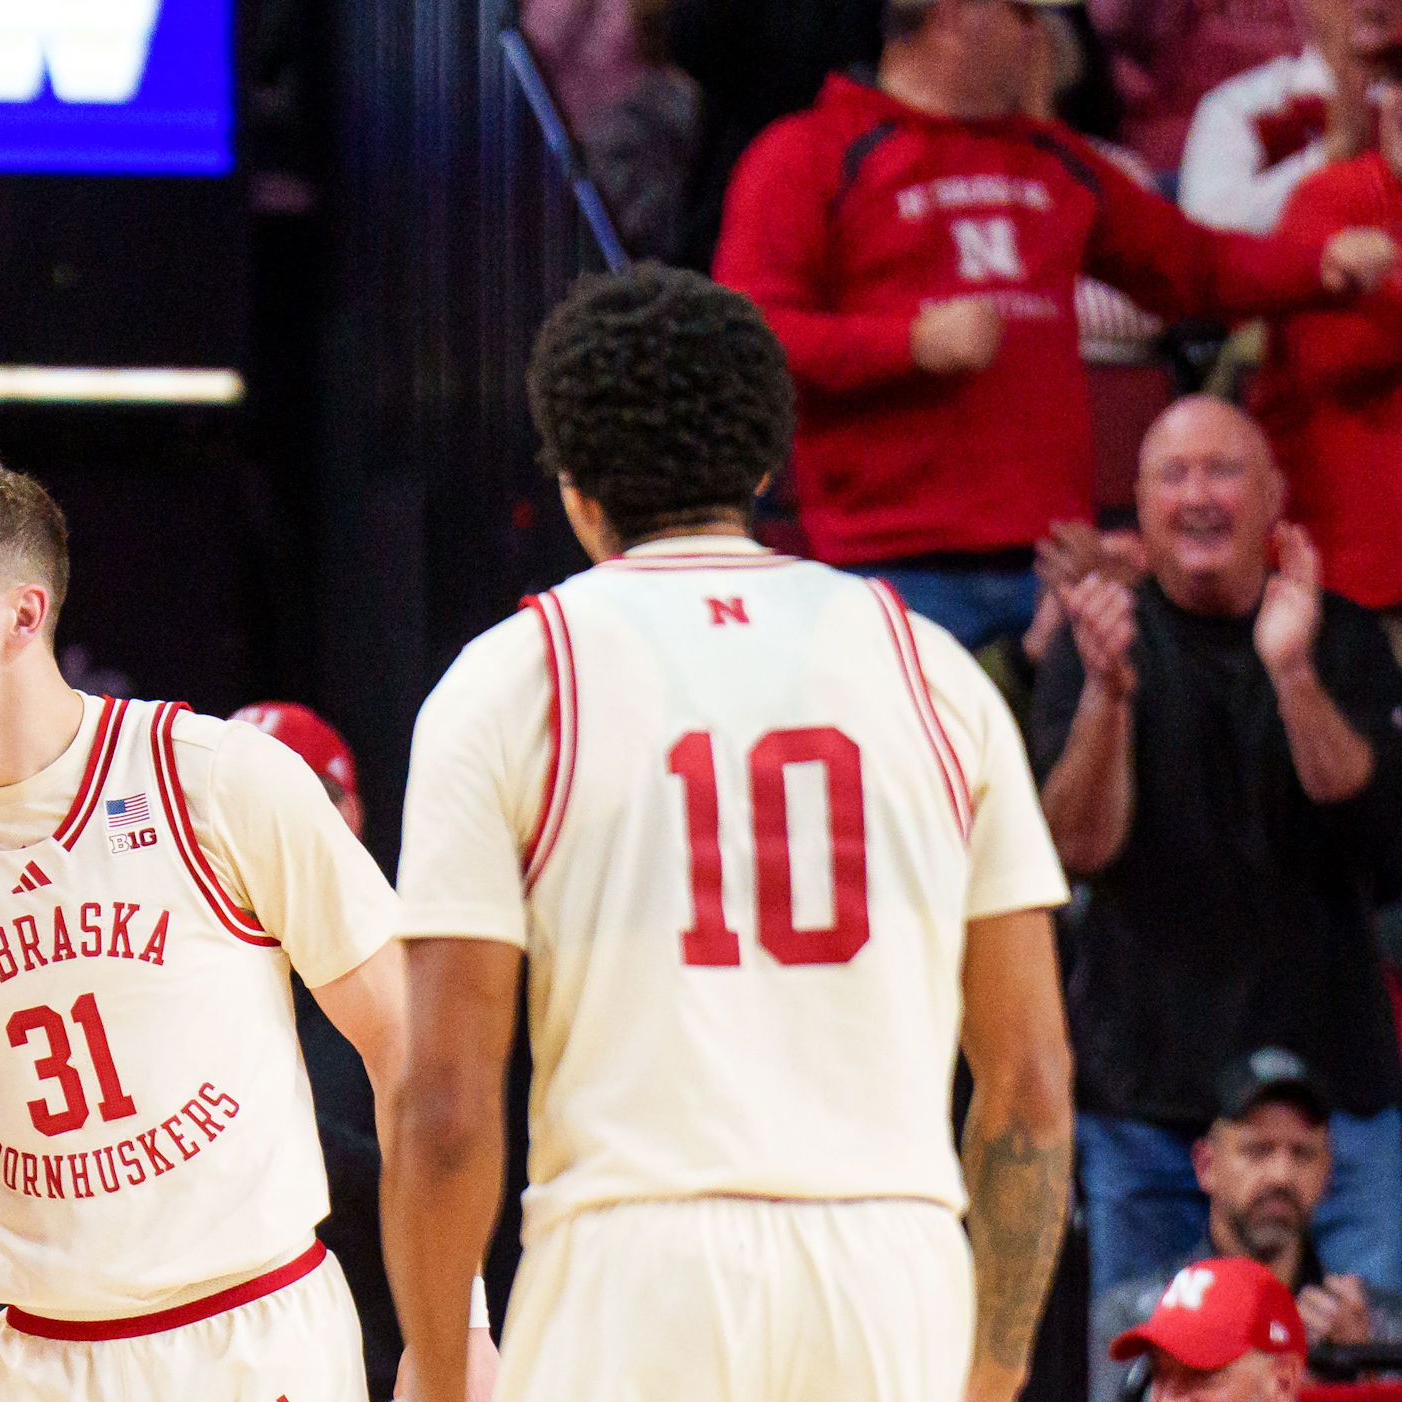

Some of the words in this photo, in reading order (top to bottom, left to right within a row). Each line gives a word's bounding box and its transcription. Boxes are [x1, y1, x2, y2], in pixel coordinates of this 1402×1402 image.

[704, 595, 751, 626] N
[666, 726, 871, 967] 10
[5, 992, 137, 1137] 31
[1160, 1267, 1215, 1311] N
